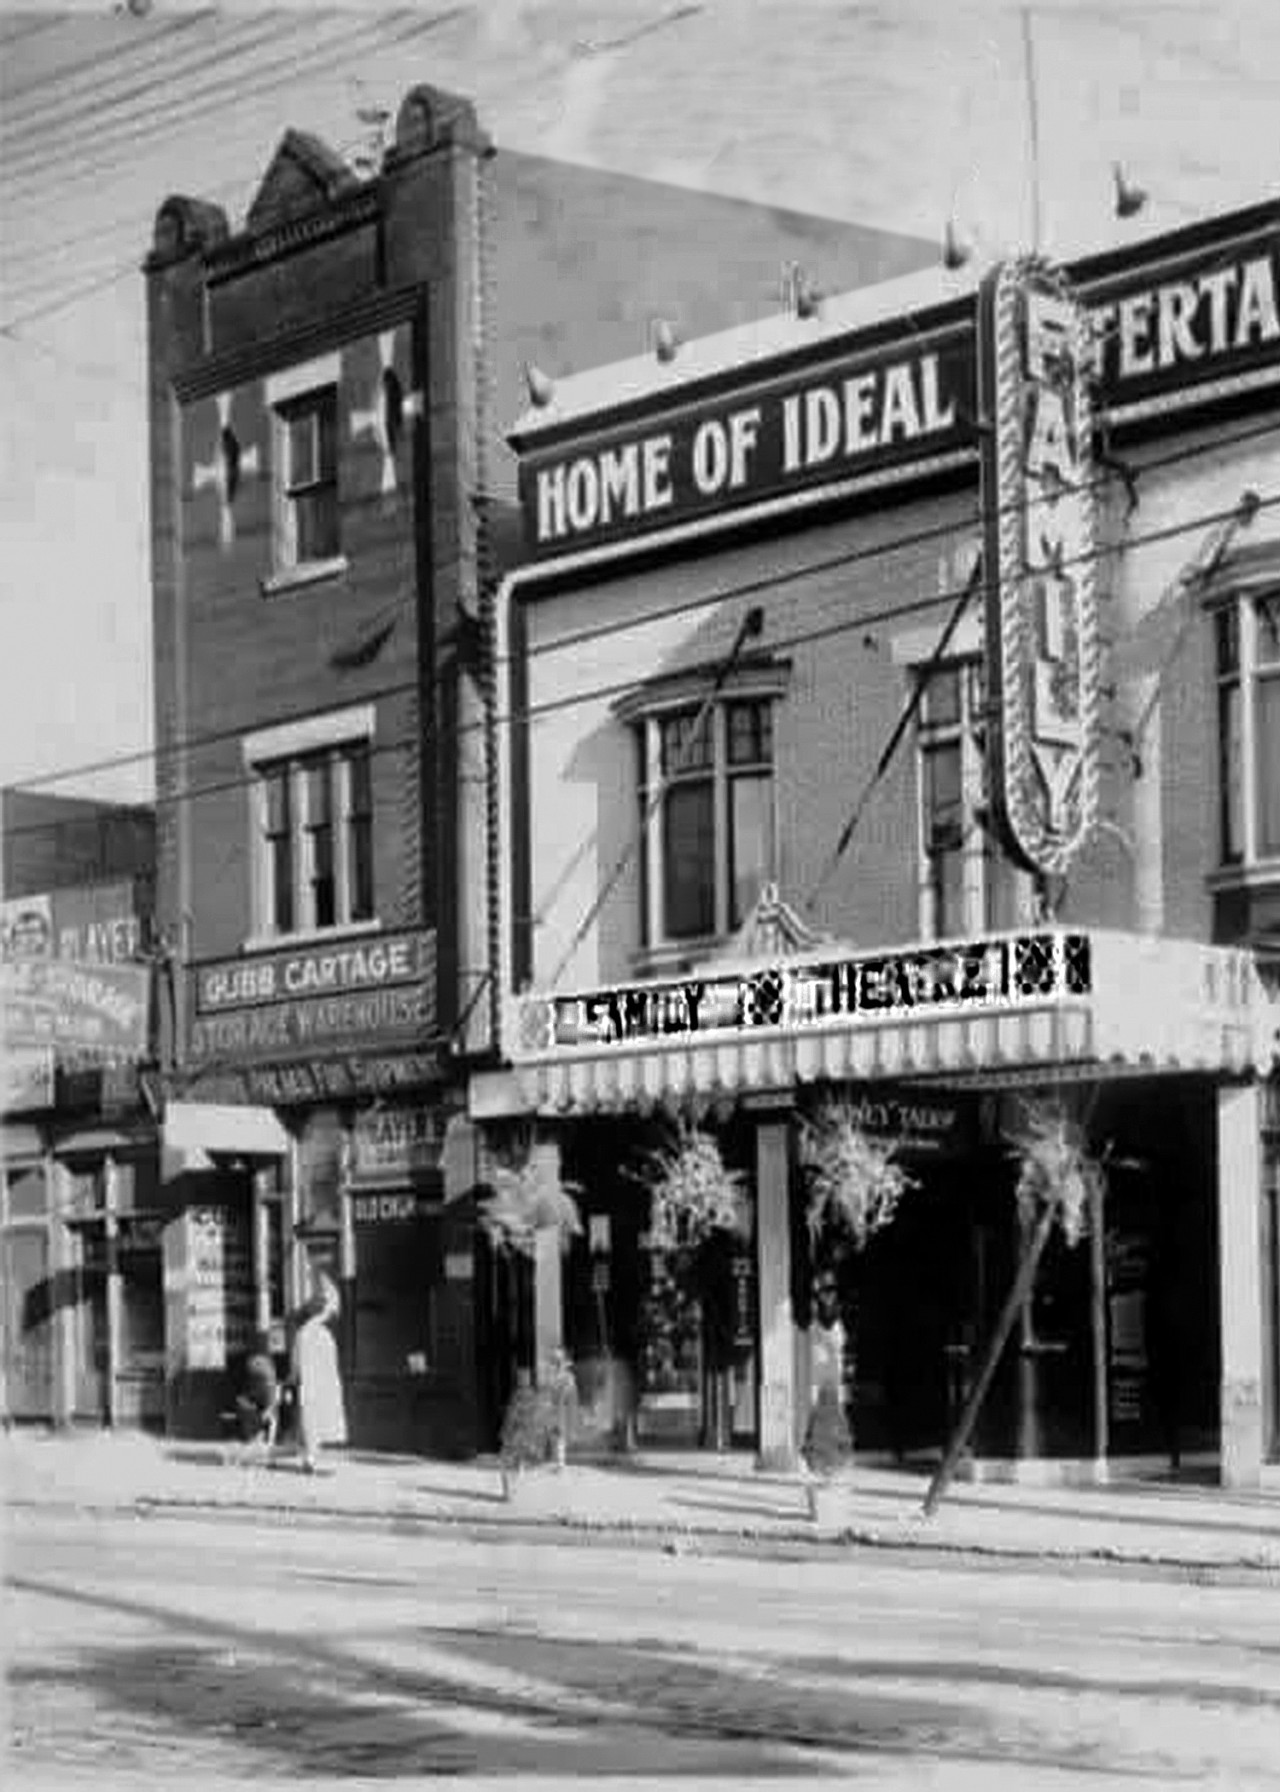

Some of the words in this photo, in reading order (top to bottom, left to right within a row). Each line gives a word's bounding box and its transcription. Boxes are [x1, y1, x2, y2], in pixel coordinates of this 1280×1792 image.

[537, 435, 674, 542] HOME
[693, 408, 762, 494] OF
[783, 354, 956, 473] IDEAL
[1022, 290, 1085, 833] FAMILY
[285, 943, 410, 990] CARTAGE
